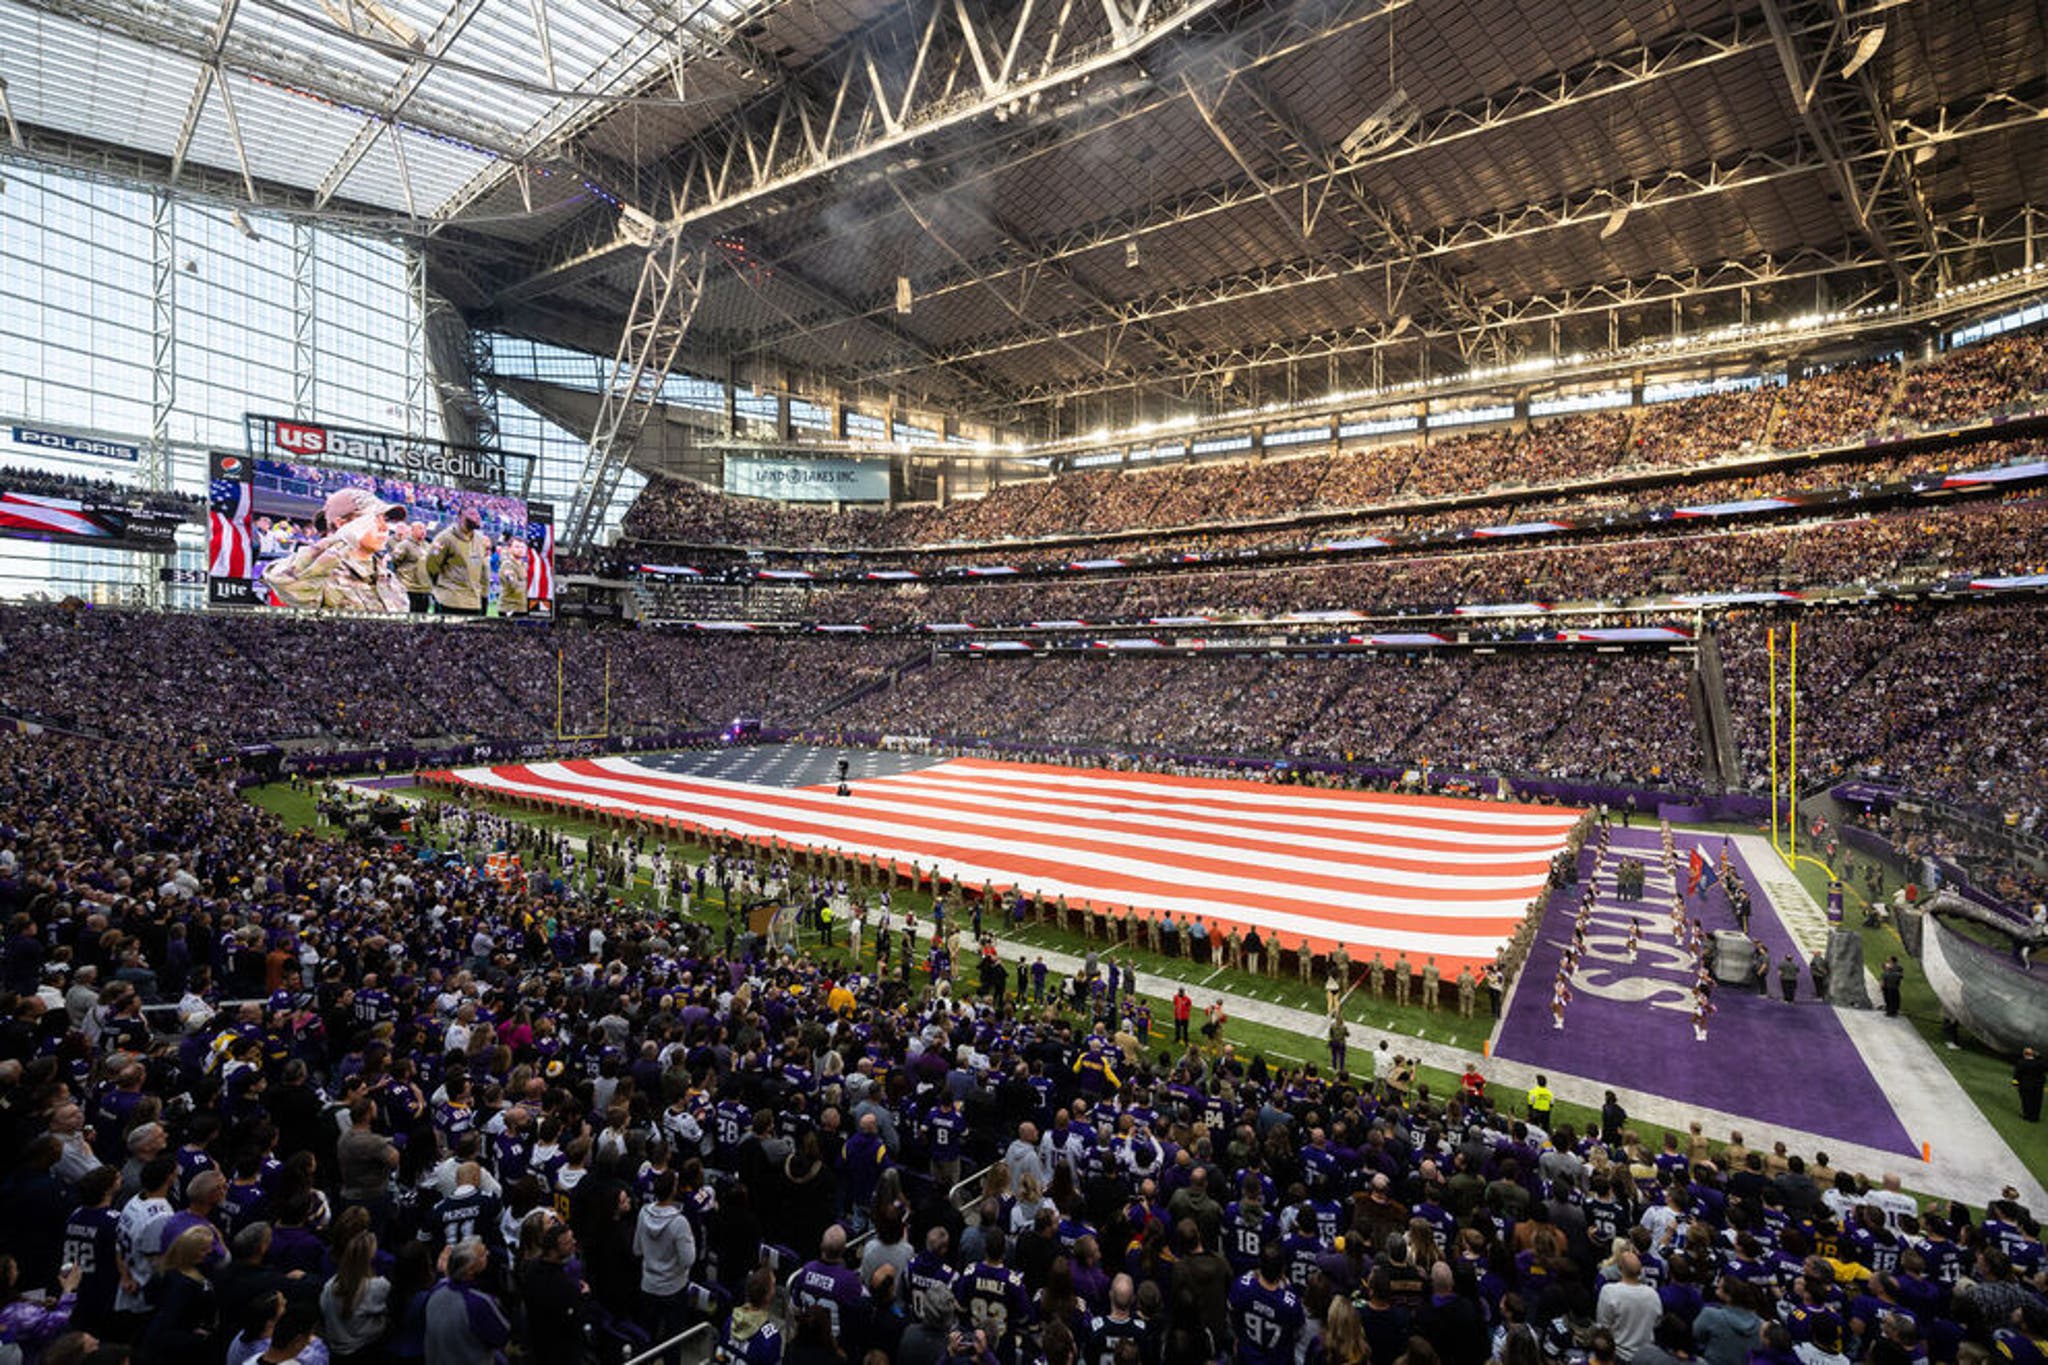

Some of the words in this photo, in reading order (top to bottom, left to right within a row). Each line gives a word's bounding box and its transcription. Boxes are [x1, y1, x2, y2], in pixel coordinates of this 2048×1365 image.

[20, 430, 133, 459] POLARIS
[326, 430, 406, 465] bank
[405, 447, 508, 481] stadium
[756, 471, 785, 483] LAND
[803, 471, 835, 483] LAKES
[836, 471, 859, 483] INC.
[216, 582, 248, 598] Lite
[1204, 1109, 1225, 1130] 84
[62, 1239, 97, 1274] 82
[1236, 1229, 1261, 1256] 18
[1244, 1311, 1282, 1348] 97
